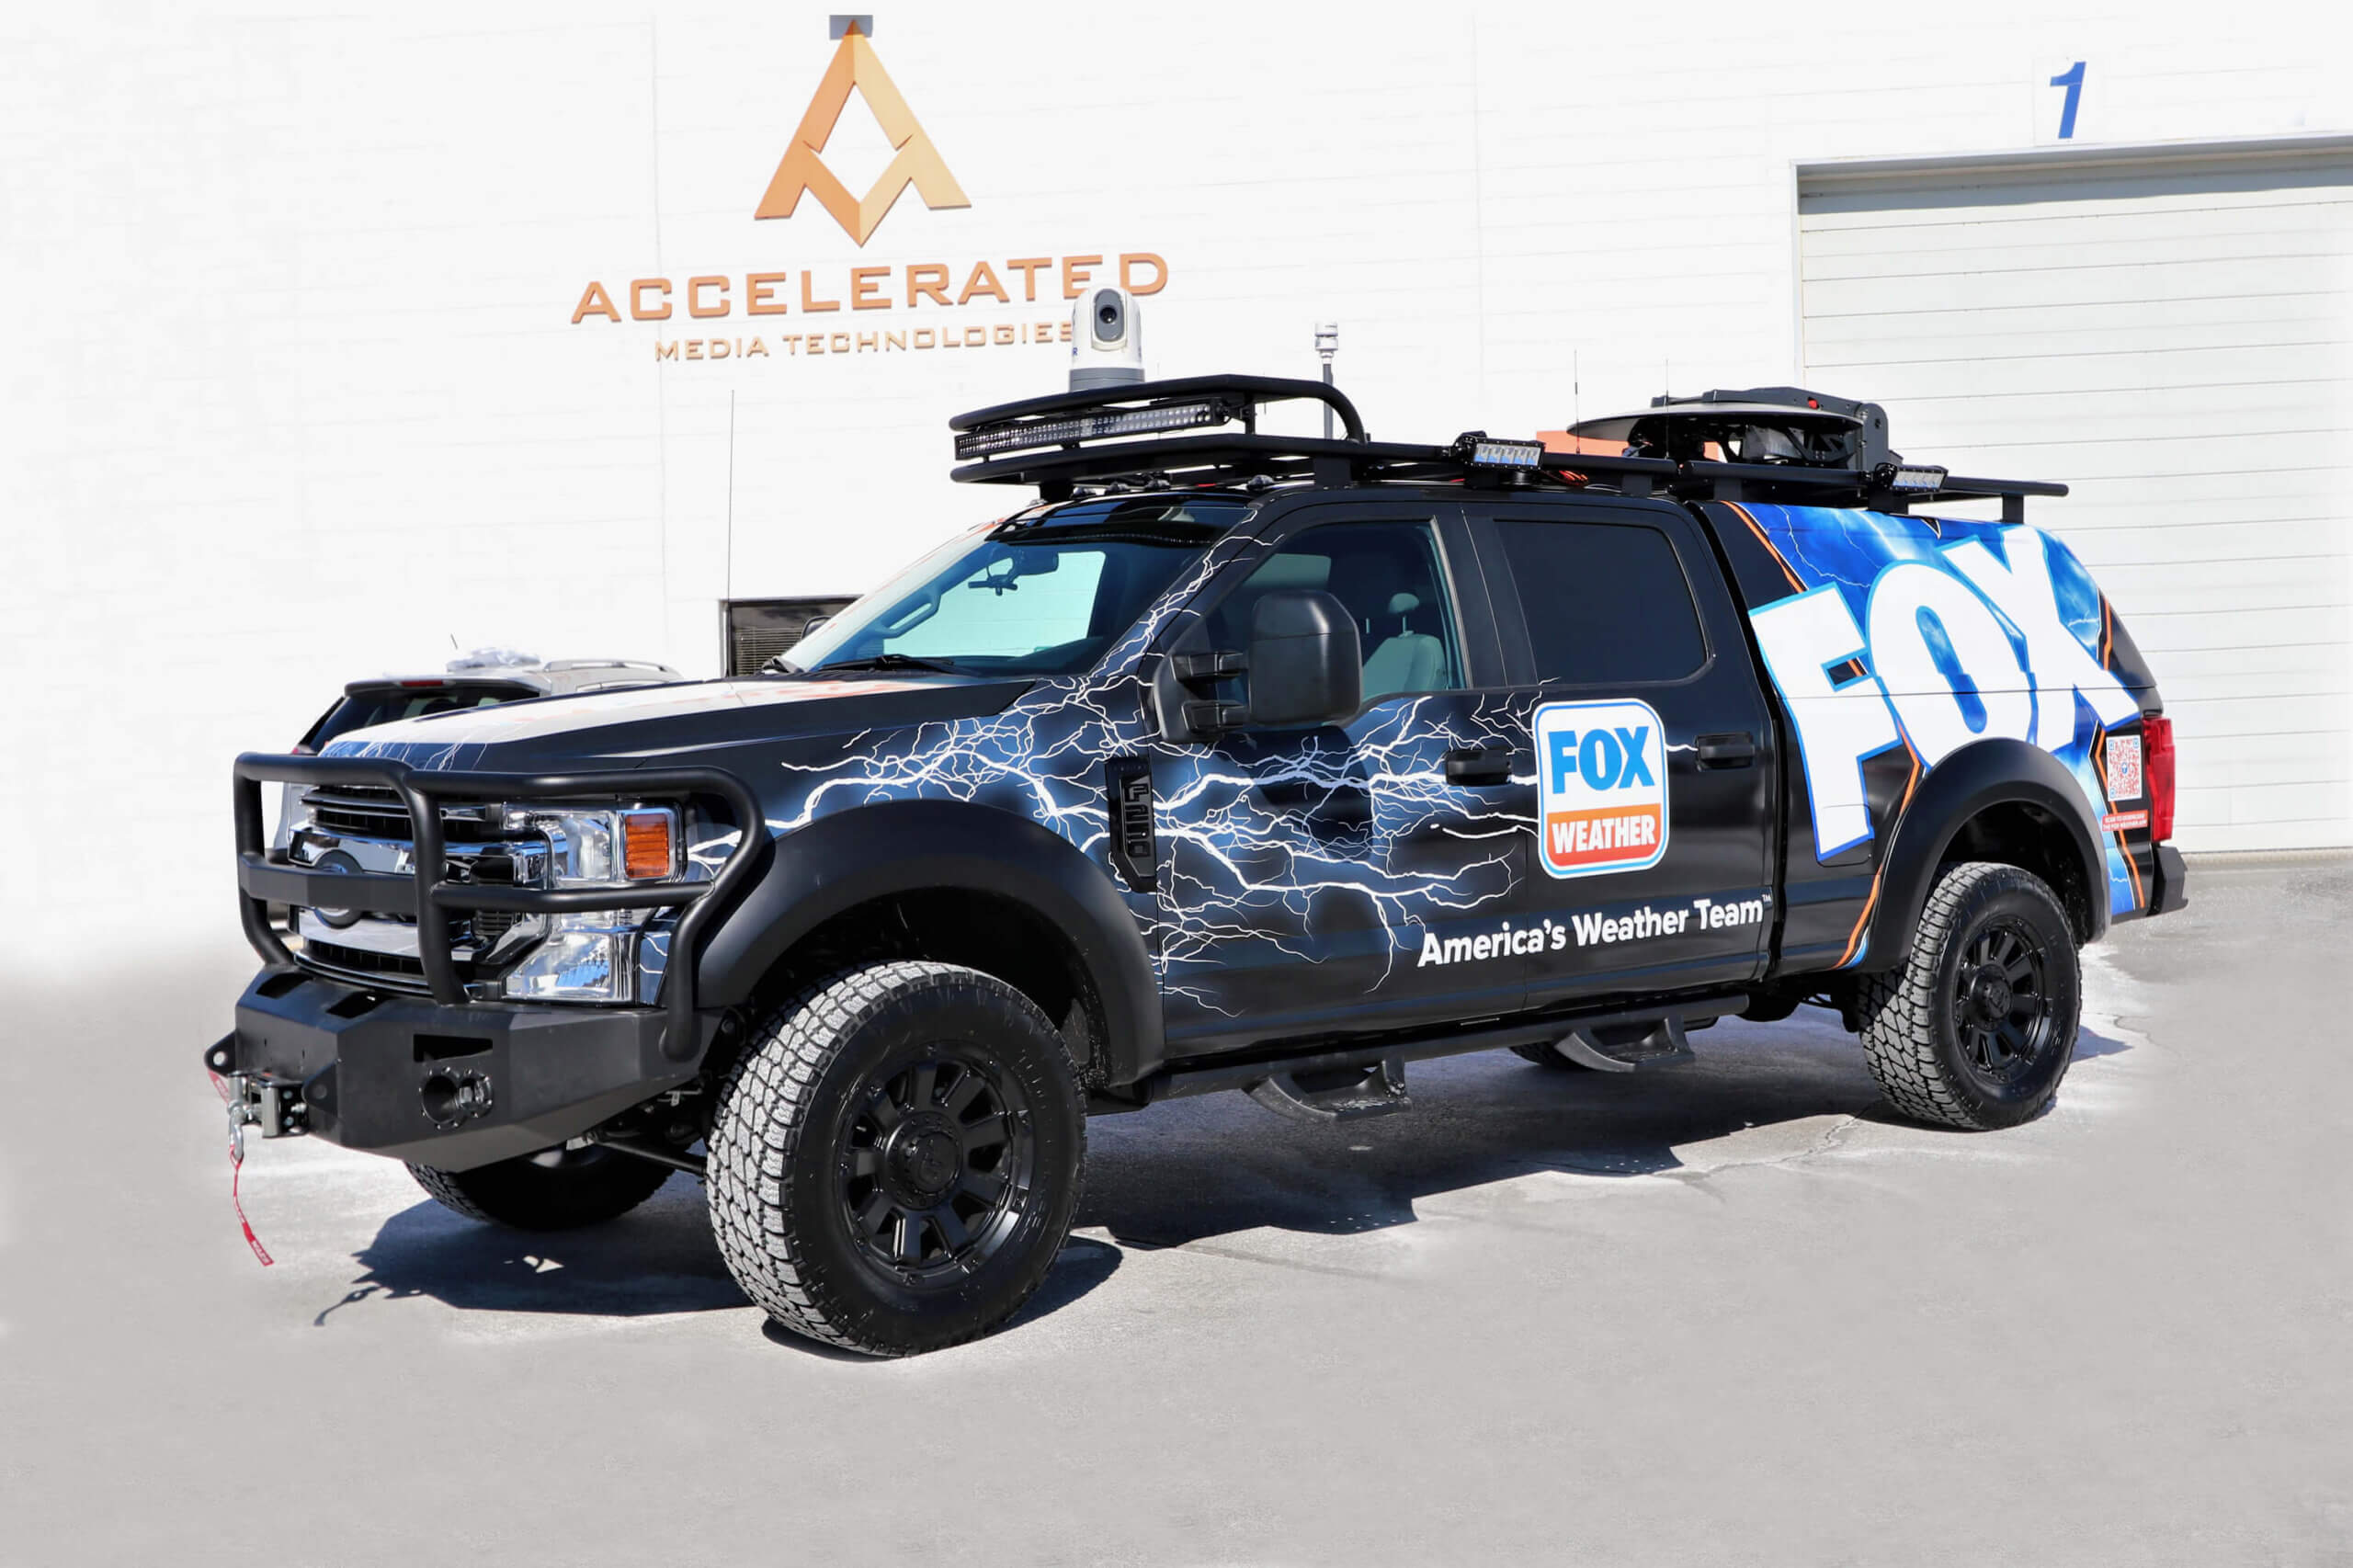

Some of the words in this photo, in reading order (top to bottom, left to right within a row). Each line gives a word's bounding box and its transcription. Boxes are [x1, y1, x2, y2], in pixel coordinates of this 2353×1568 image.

[2050, 61, 2086, 139] 1
[571, 253, 1168, 324] ACCELERATED
[655, 337, 769, 362] MEDIA
[782, 321, 1073, 356] TECHNOLOGIES
[1748, 524, 2140, 861] FOX
[1548, 725, 1655, 794] FOX
[1551, 814, 1656, 855] WEATHER
[1417, 919, 1566, 968] America's
[1572, 905, 1689, 947] Weather
